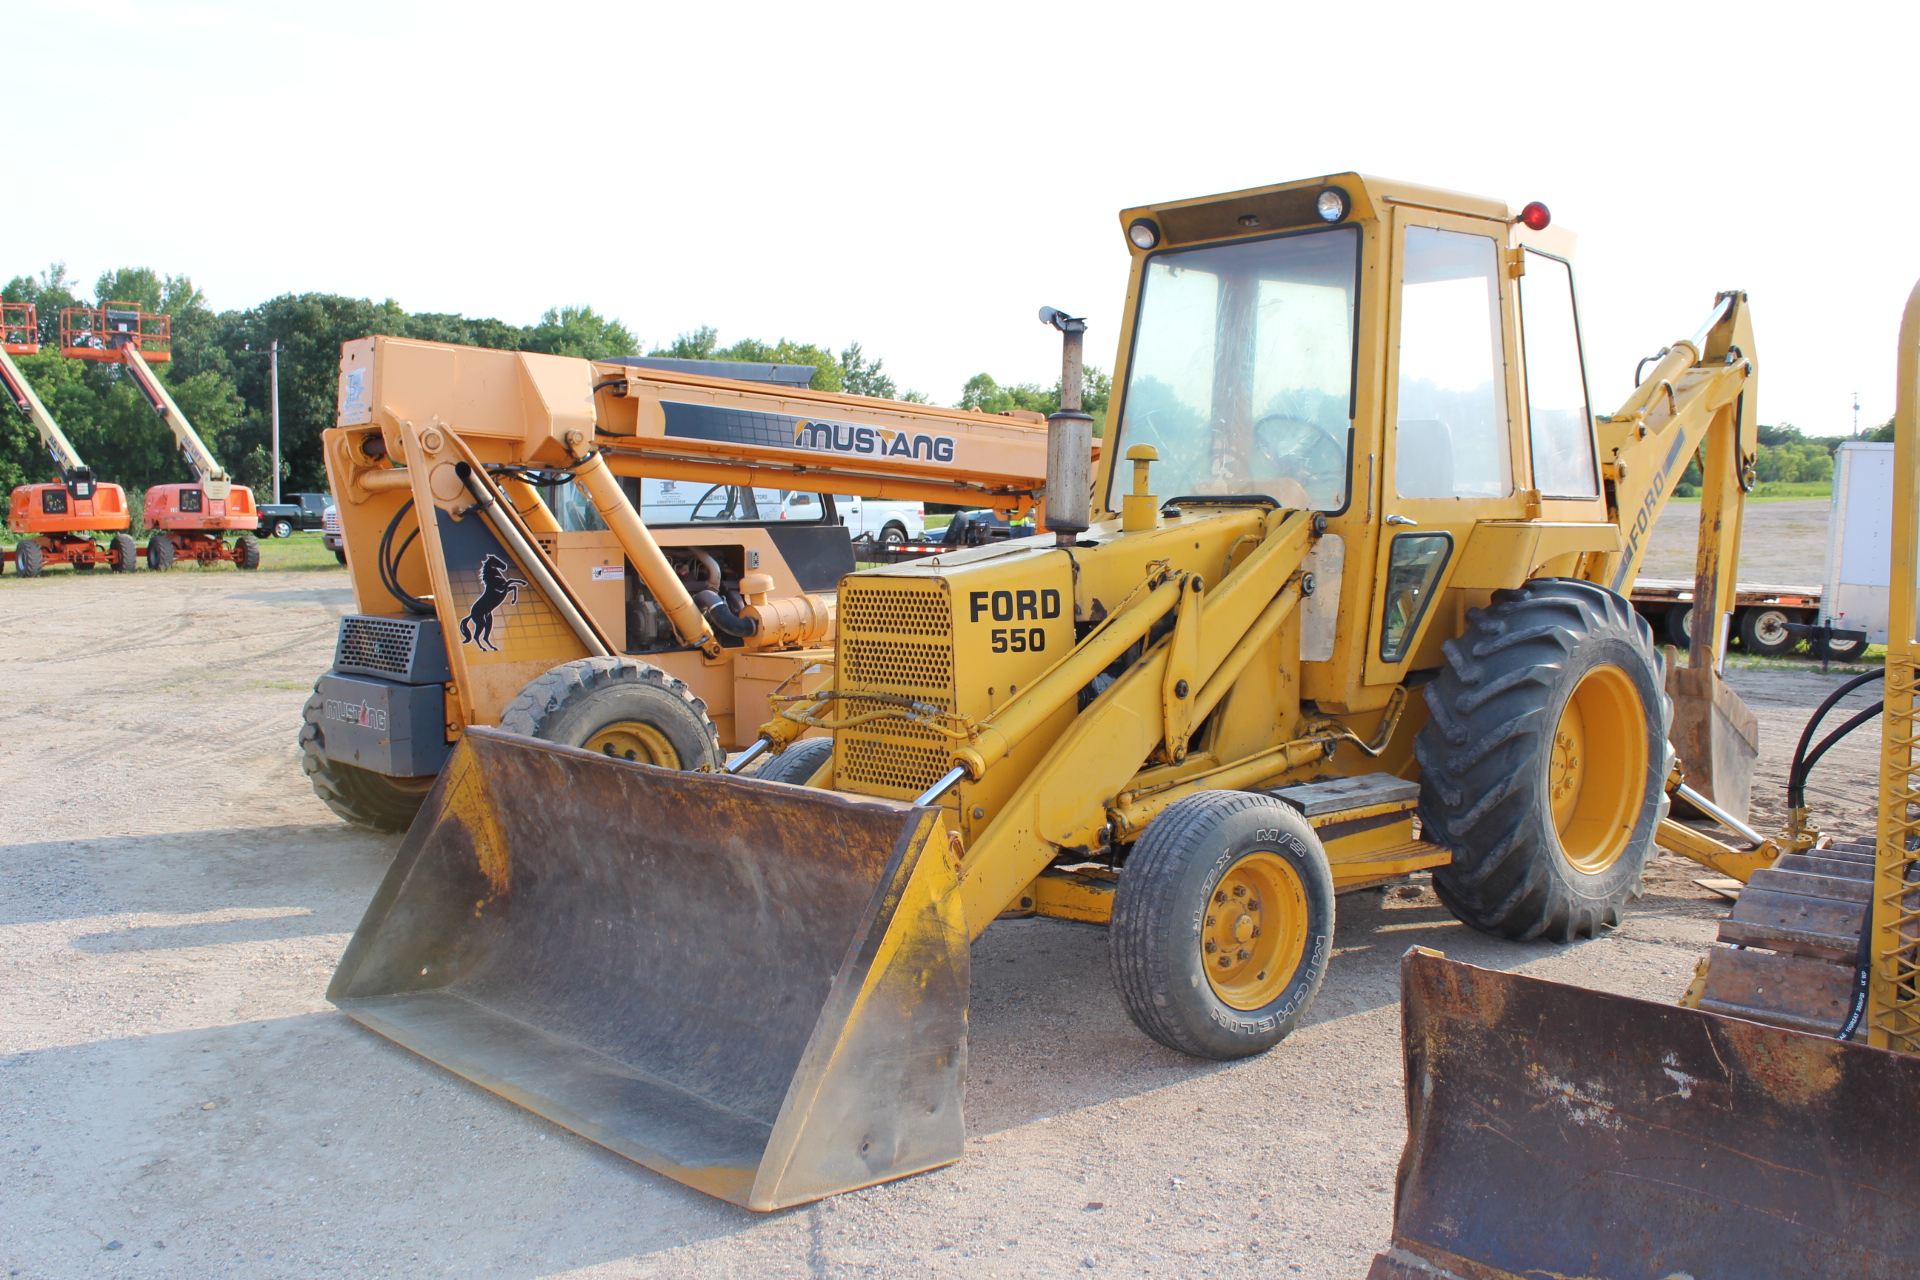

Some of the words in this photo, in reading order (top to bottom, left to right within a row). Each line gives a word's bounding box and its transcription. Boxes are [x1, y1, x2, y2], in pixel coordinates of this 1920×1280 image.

[795, 419, 955, 462] MUSTANG
[1629, 471, 1664, 552] FORD
[970, 589, 1060, 623] FORD
[992, 628, 1045, 653] 550
[1256, 829, 1307, 858] M/S
[1211, 935, 1327, 1034] MICHELIN
